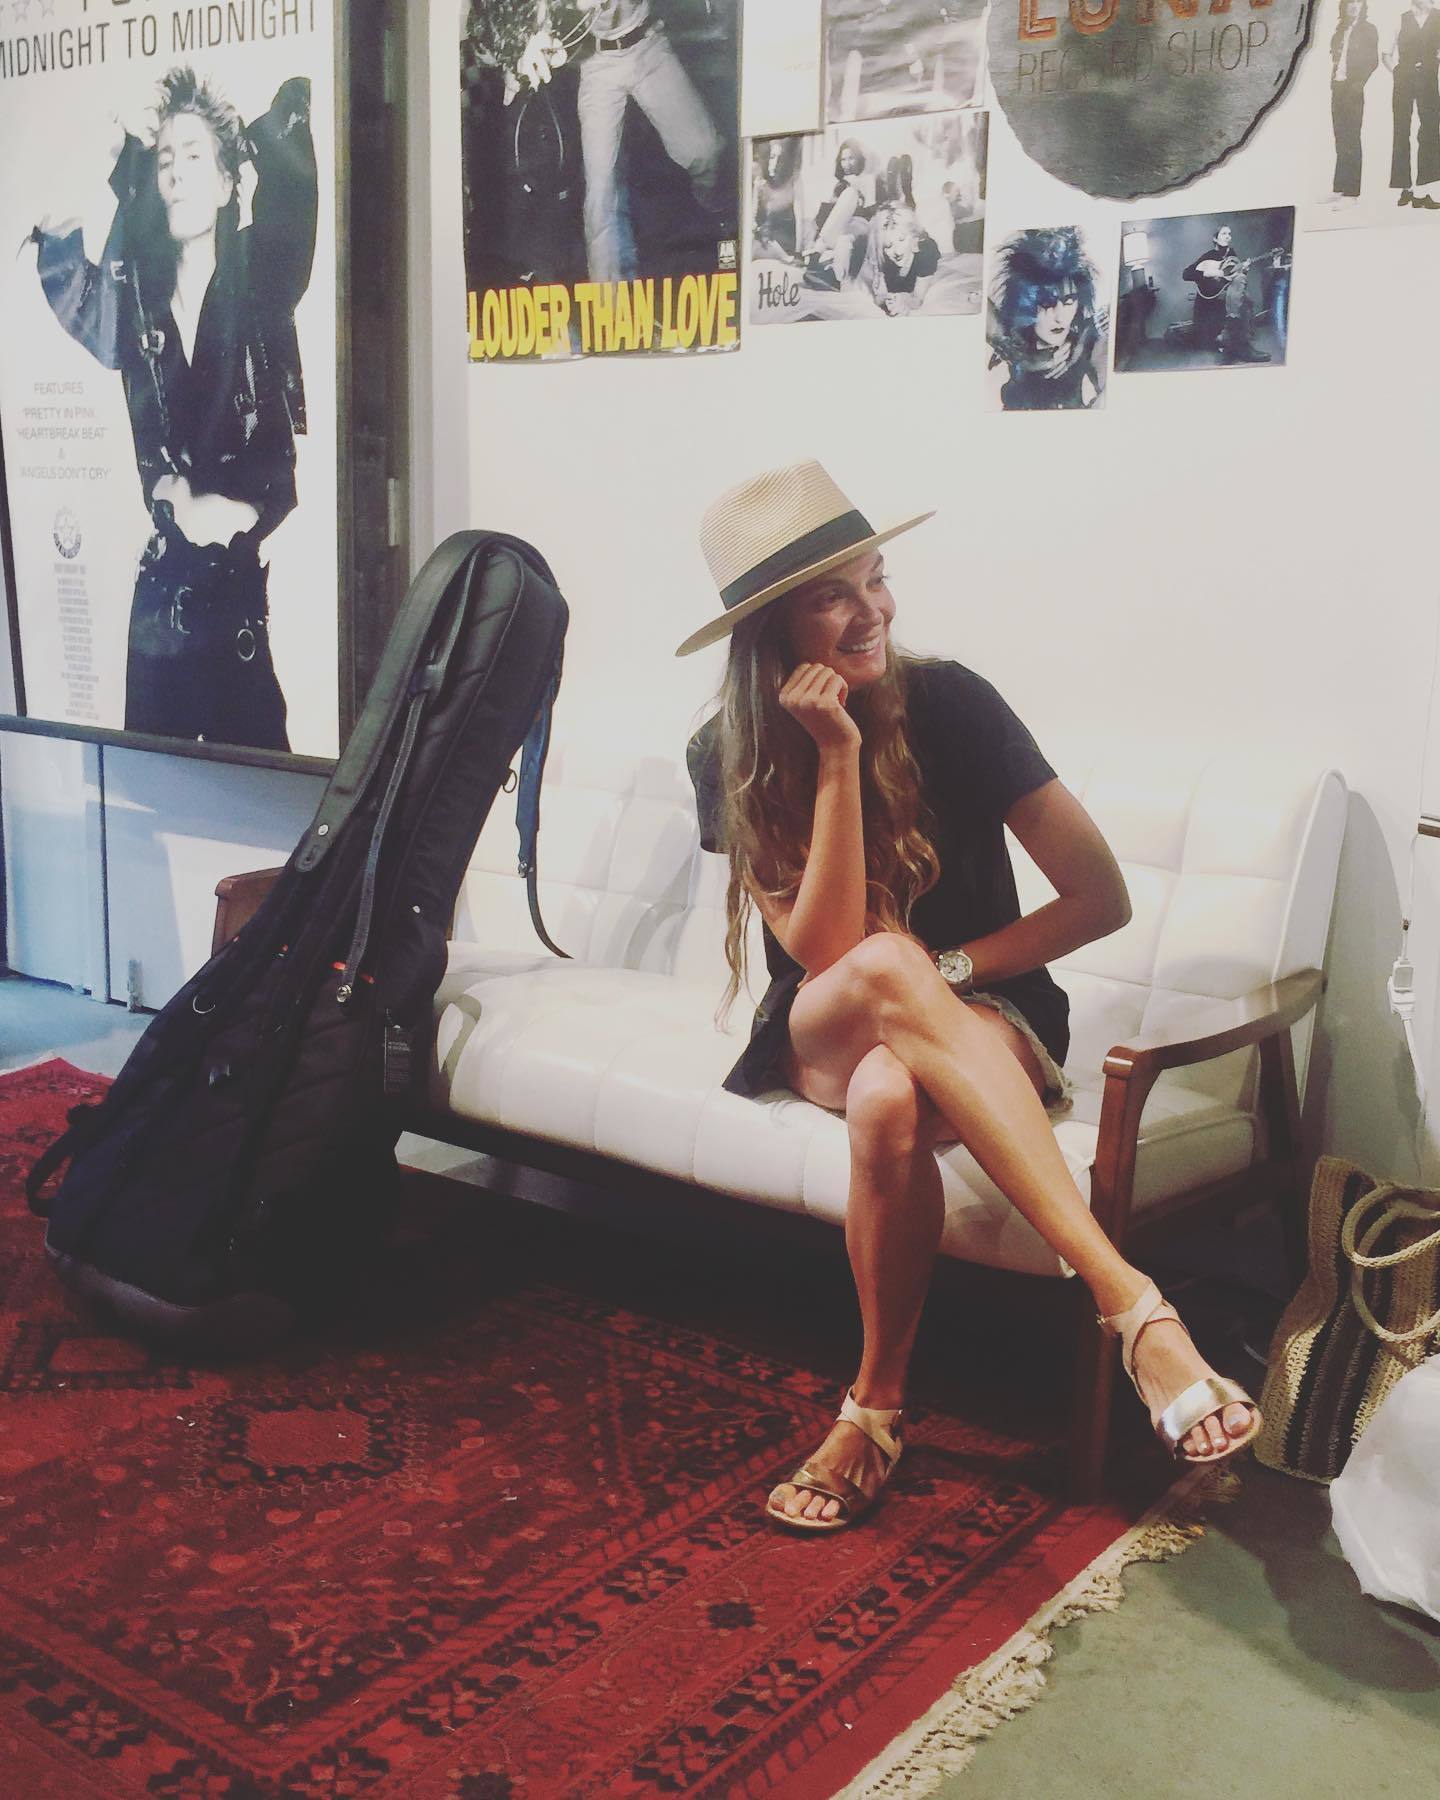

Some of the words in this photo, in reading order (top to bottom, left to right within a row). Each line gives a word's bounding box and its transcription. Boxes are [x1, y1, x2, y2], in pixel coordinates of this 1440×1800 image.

[122, 14, 158, 59] TO
[1018, 0, 1274, 41] LU
[1168, 20, 1269, 78] SHOP
[758, 271, 801, 310] Hole
[469, 283, 571, 358] LOUDER
[574, 278, 655, 354] THAN
[661, 272, 737, 350] LOVE
[33, 381, 84, 395] FEATURES
